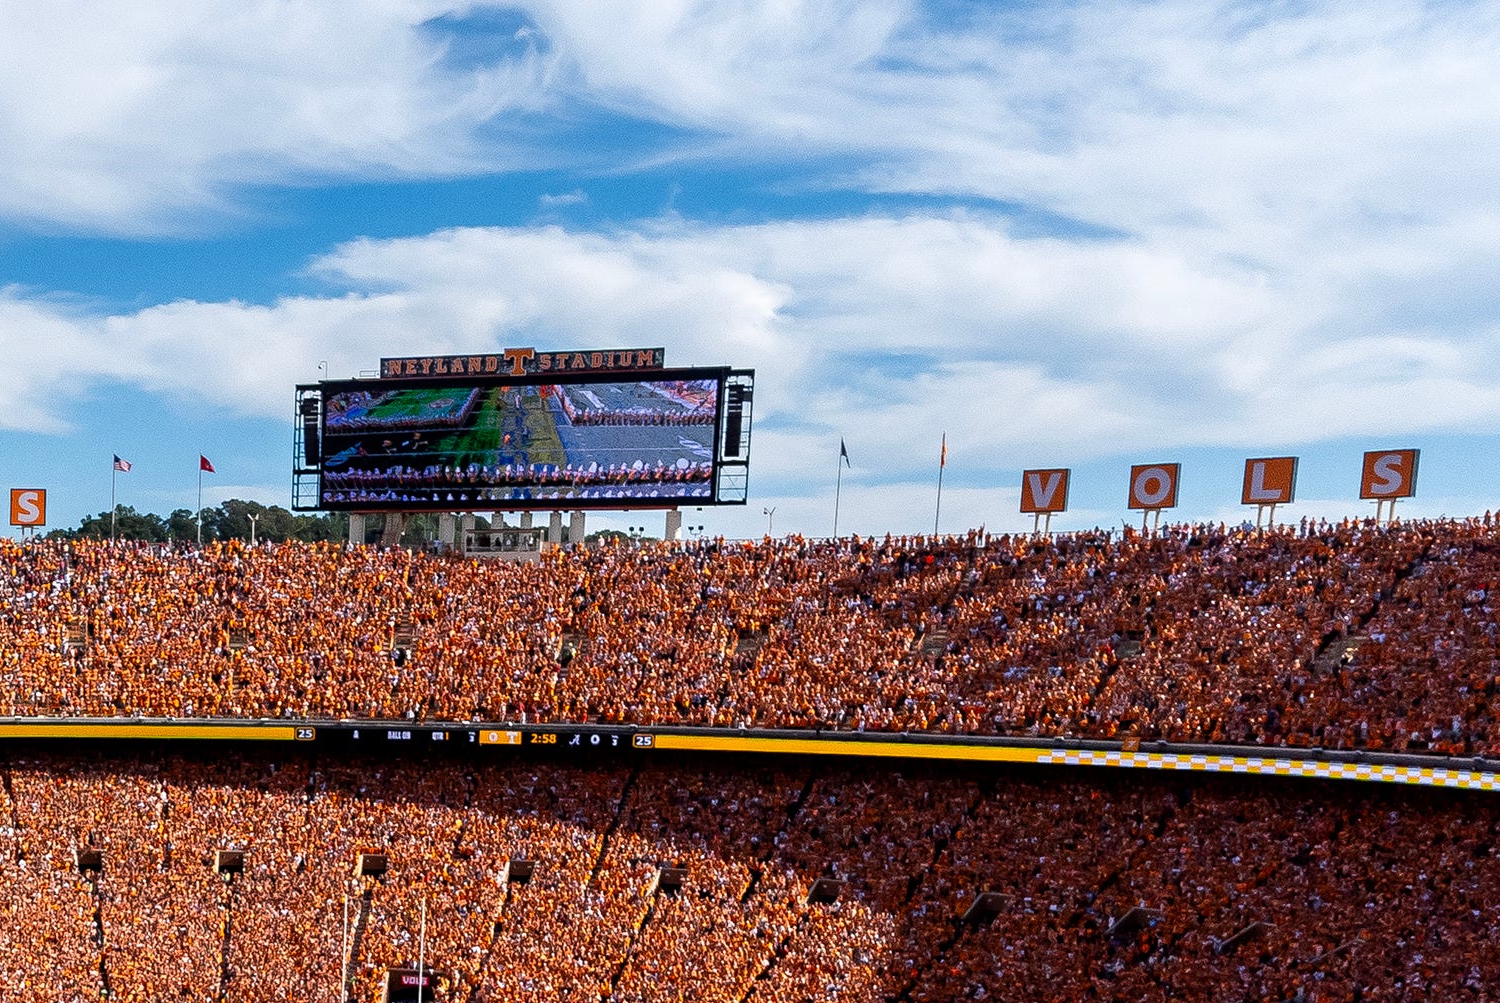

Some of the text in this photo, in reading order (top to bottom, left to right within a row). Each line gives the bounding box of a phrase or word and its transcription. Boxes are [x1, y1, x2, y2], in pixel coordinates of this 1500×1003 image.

[389, 356, 498, 376] NEYLAND
[540, 350, 654, 370] STADIUM
[298, 729, 314, 739] 25
[530, 733, 557, 744] 2:58
[636, 736, 651, 746] 25
